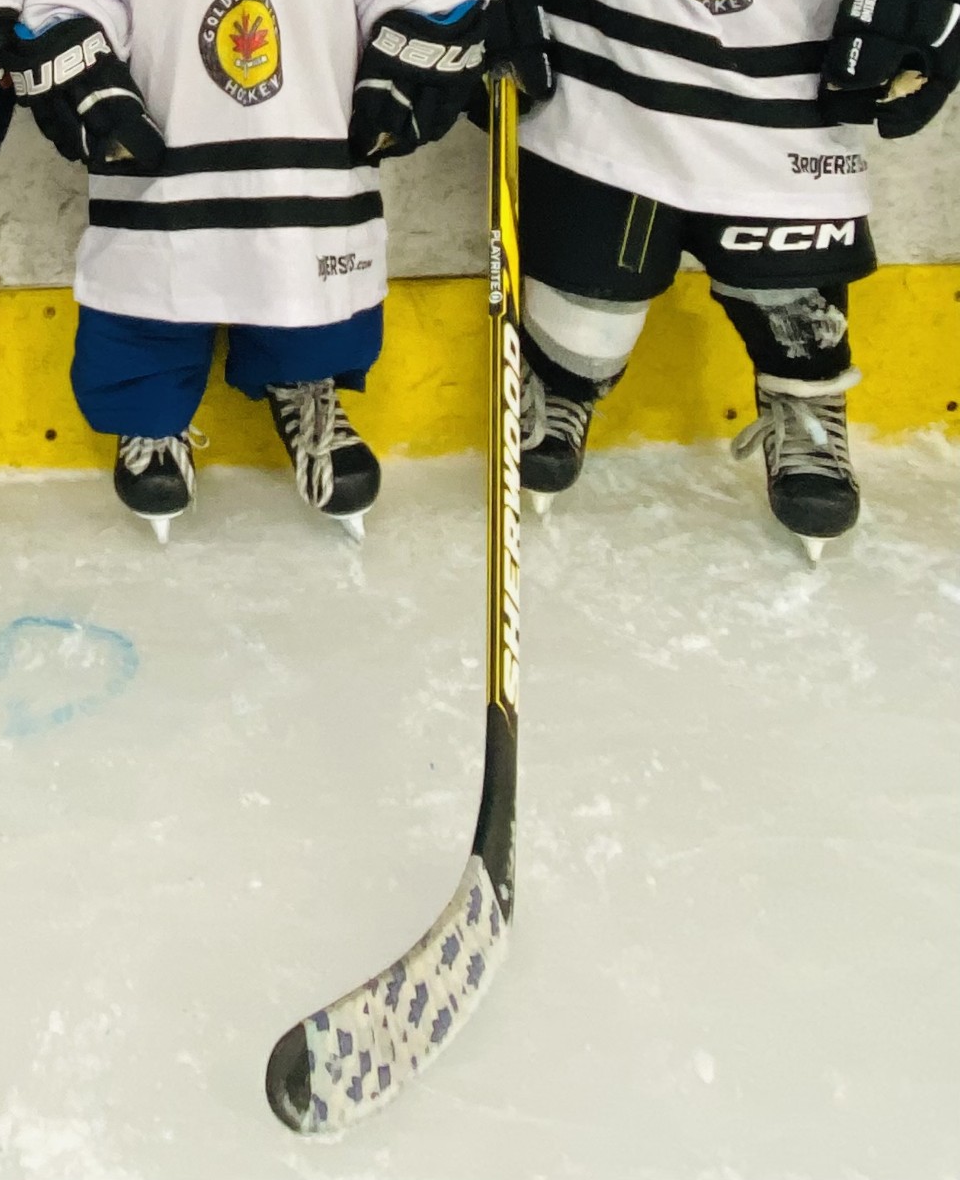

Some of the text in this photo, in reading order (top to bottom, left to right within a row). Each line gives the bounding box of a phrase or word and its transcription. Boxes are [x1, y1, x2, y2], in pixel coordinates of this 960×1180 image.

[846, 37, 863, 76] CCM
[225, 75, 278, 105] HOKEY
[720, 220, 855, 252] CCM
[490, 229, 501, 291] PLAYRITE
[503, 322, 521, 717] SHERWOOD
